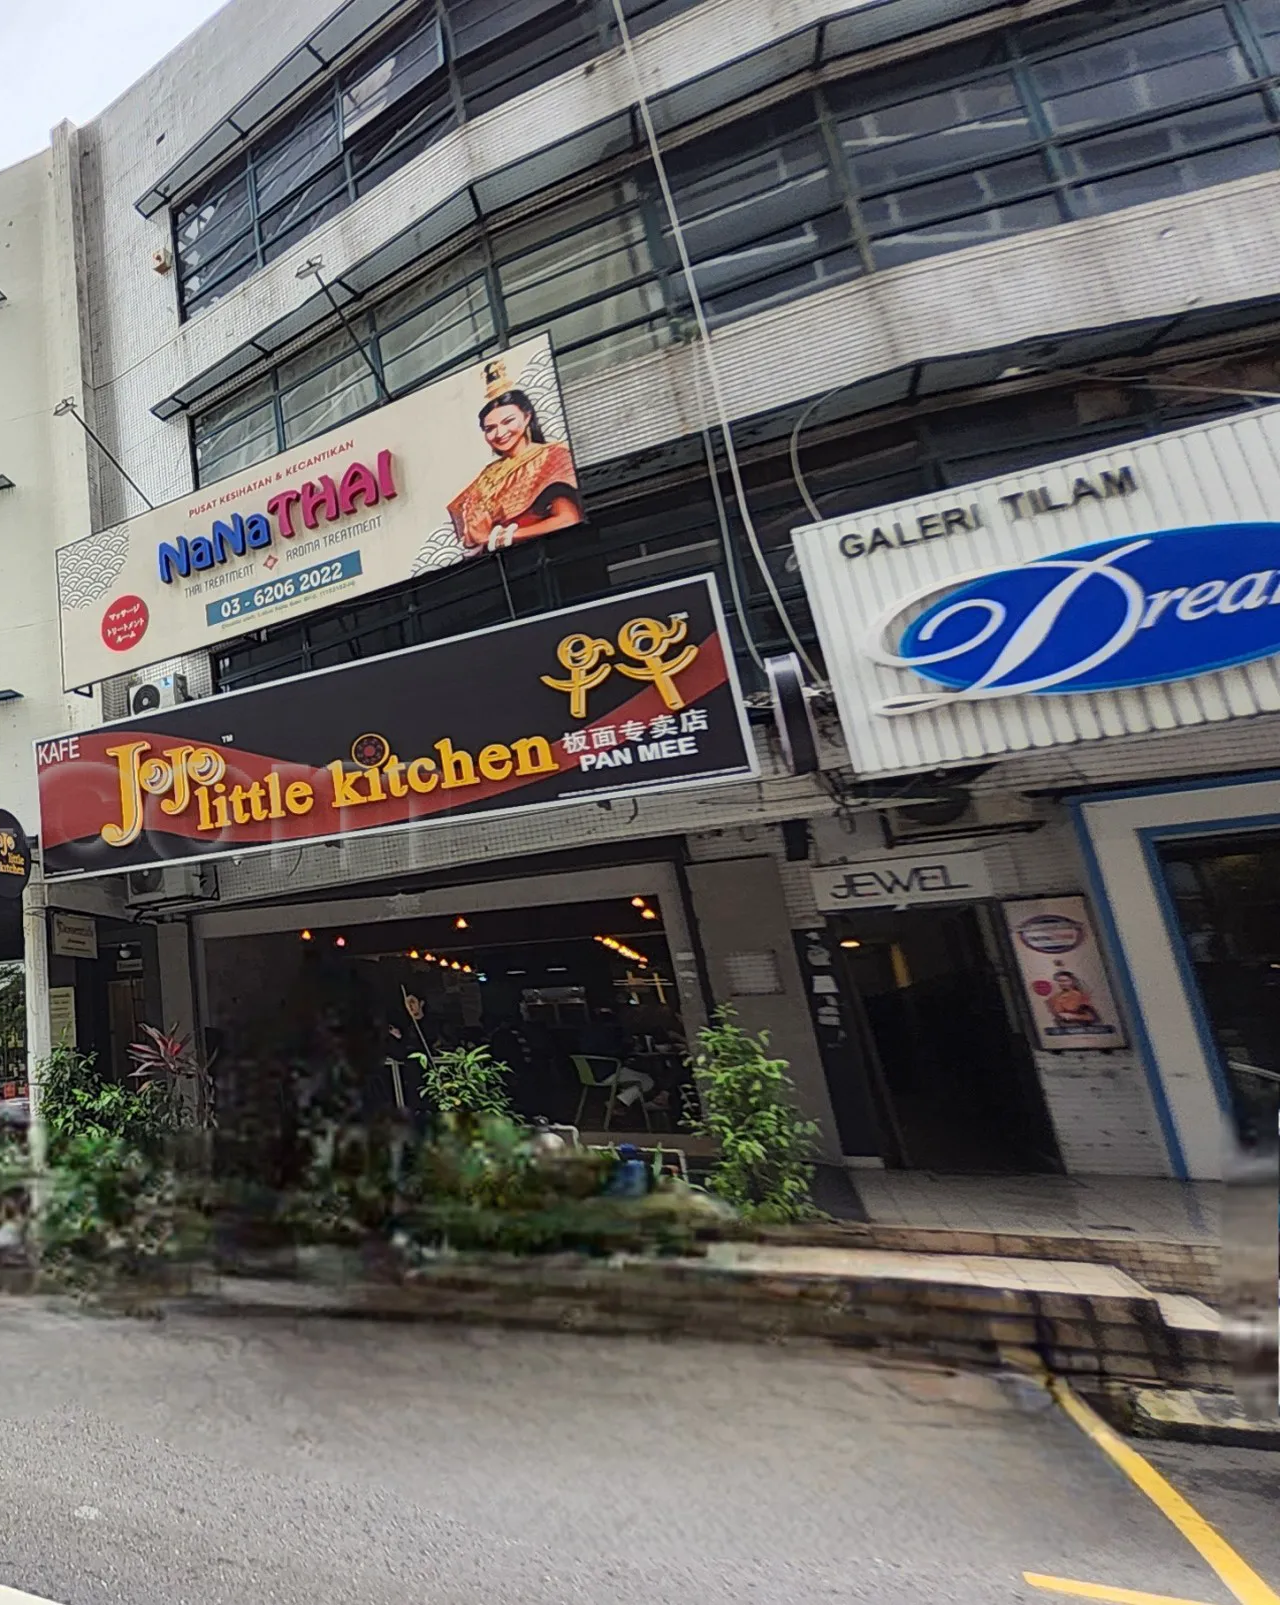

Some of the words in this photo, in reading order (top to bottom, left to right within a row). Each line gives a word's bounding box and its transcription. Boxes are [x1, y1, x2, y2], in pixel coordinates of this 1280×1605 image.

[189, 499, 218, 518] PUSAT
[219, 476, 273, 505] KESIHATAN
[274, 472, 283, 481] &
[285, 440, 355, 476] KECANTIKAN
[839, 503, 987, 559] GALERI
[998, 465, 1138, 522] TILAM
[184, 583, 203, 598] THAI
[204, 563, 255, 592] TREATMENT
[285, 539, 321, 562] AROMA
[322, 515, 383, 548] TREATMENT
[221, 598, 241, 618] 03
[253, 579, 295, 607] 6206
[299, 561, 343, 592] 2022
[38, 736, 81, 765] KAFE
[562, 708, 709, 754] 板面专卖店
[579, 747, 633, 772] PAN
[637, 736, 699, 762] MEE
[194, 772, 314, 831] little
[331, 734, 559, 809] kitchen
[829, 865, 974, 899] JEWEL
